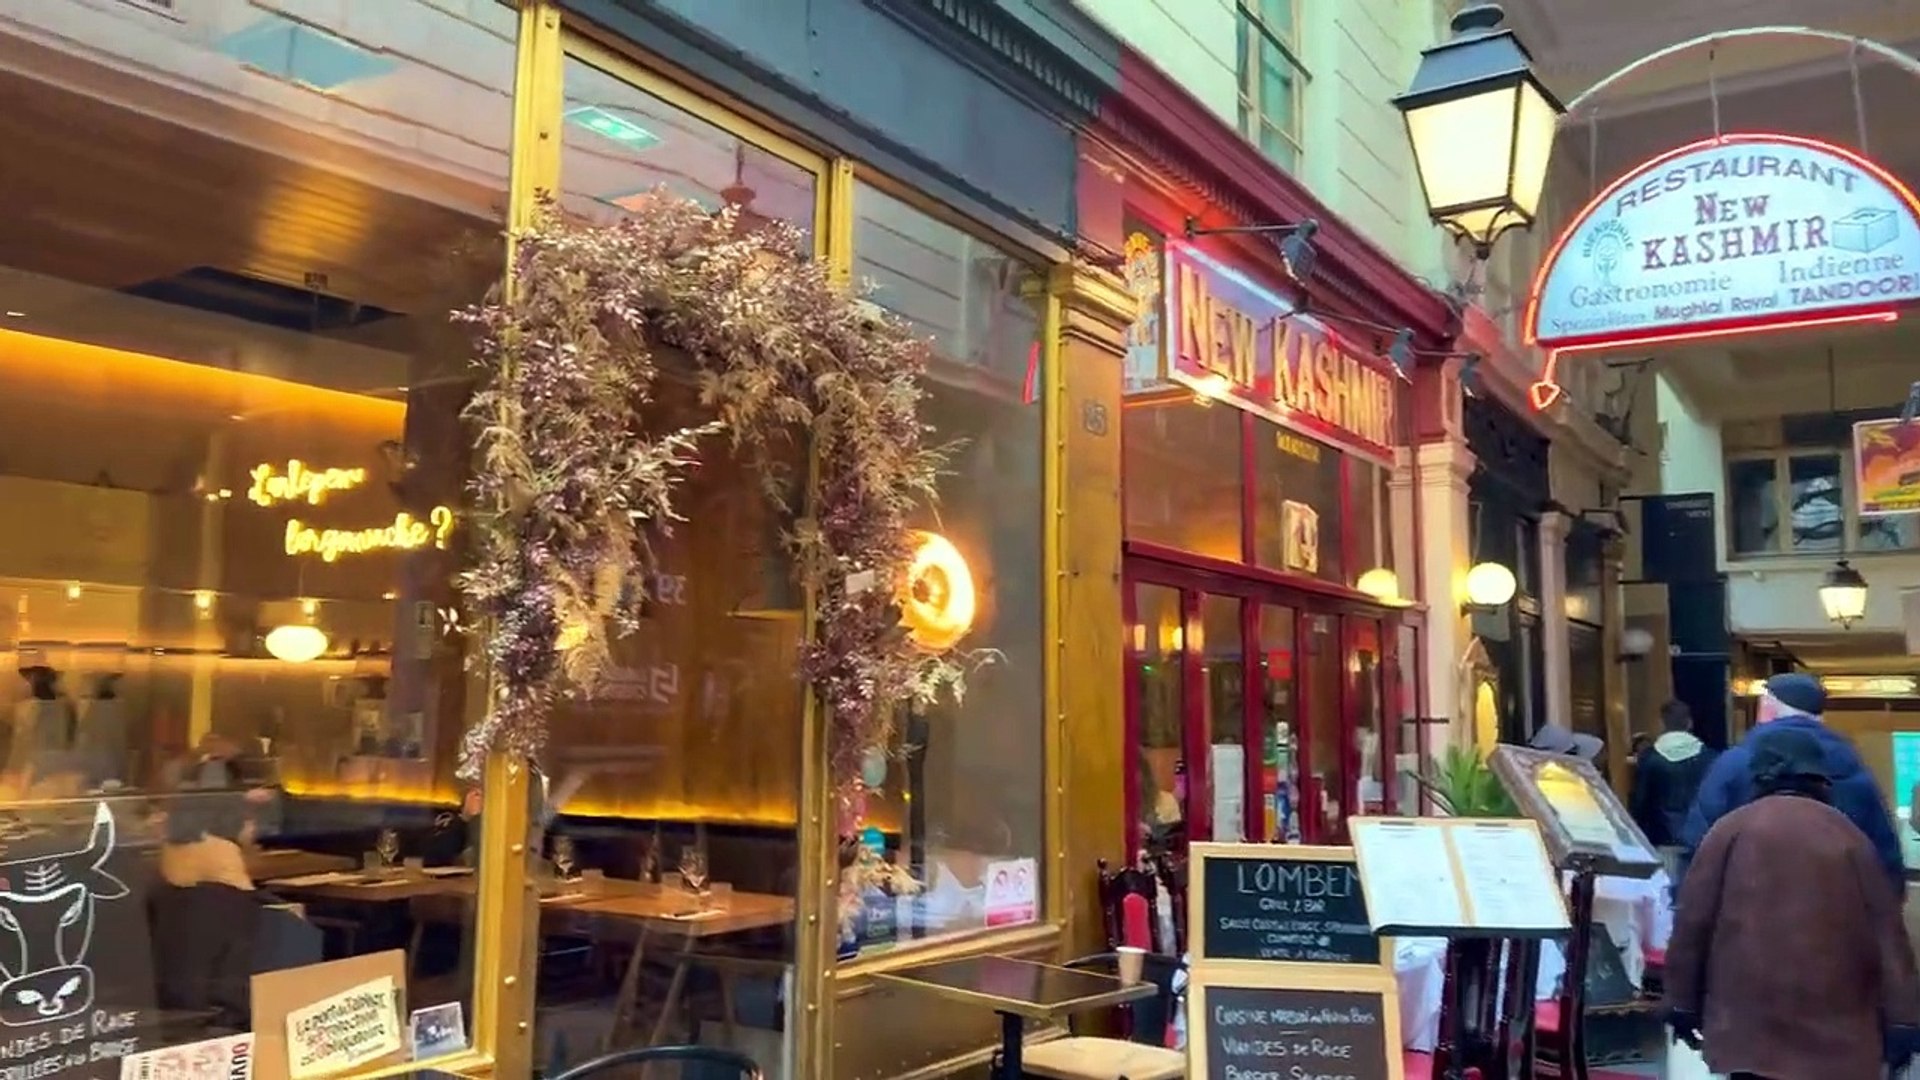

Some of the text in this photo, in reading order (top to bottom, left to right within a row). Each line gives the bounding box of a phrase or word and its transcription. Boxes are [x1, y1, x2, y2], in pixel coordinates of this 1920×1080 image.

[1616, 155, 1860, 218] RESTAURANT
[1640, 215, 1829, 270] KASHMIR
[1569, 254, 1904, 308] Gastronomie Indienne
[1790, 271, 1920, 306] TANDOORI
[1178, 262, 1257, 391] NEW
[1215, 1005, 1269, 1026] CUISINE
[231, 1042, 249, 1080] OUV
[1221, 1036, 1288, 1057] VIANDES
[1311, 1037, 1353, 1059] RACE
